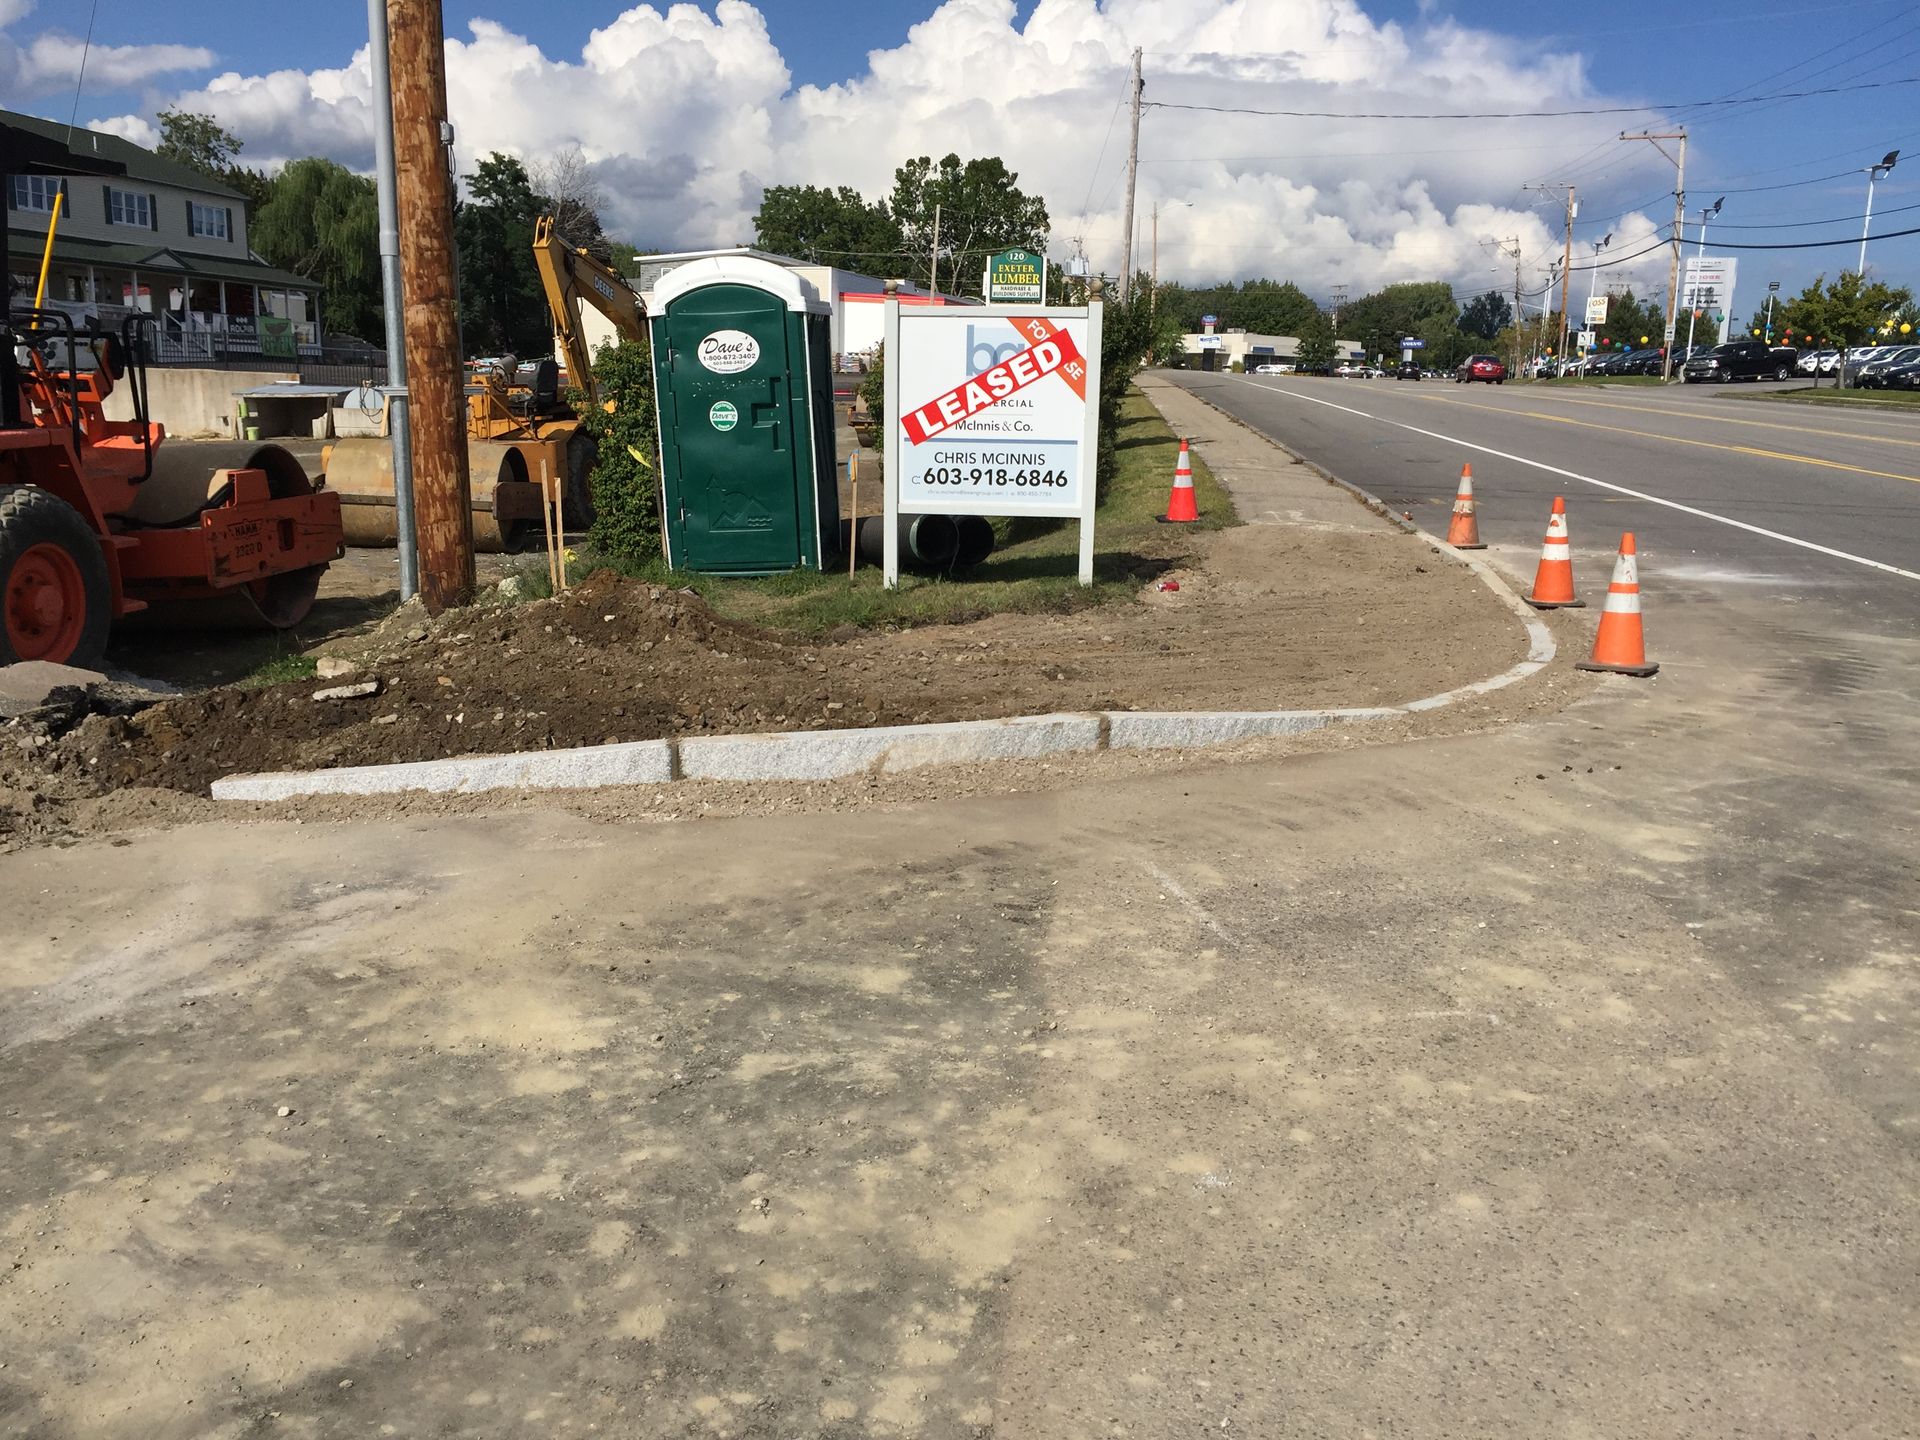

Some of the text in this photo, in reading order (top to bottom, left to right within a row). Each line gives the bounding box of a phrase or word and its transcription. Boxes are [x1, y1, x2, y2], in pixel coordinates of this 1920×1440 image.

[1009, 252, 1025, 261] 120
[998, 264, 1035, 273] EXETER
[992, 273, 1040, 284] LUMBER
[593, 274, 615, 300] DEERE
[703, 336, 755, 354] Dave's
[914, 341, 1063, 437] LEASED
[955, 420, 1034, 432] McInnis & Co.
[934, 452, 1046, 466] CHRIS MCINNIS
[923, 467, 1068, 488] 603-918-6846
